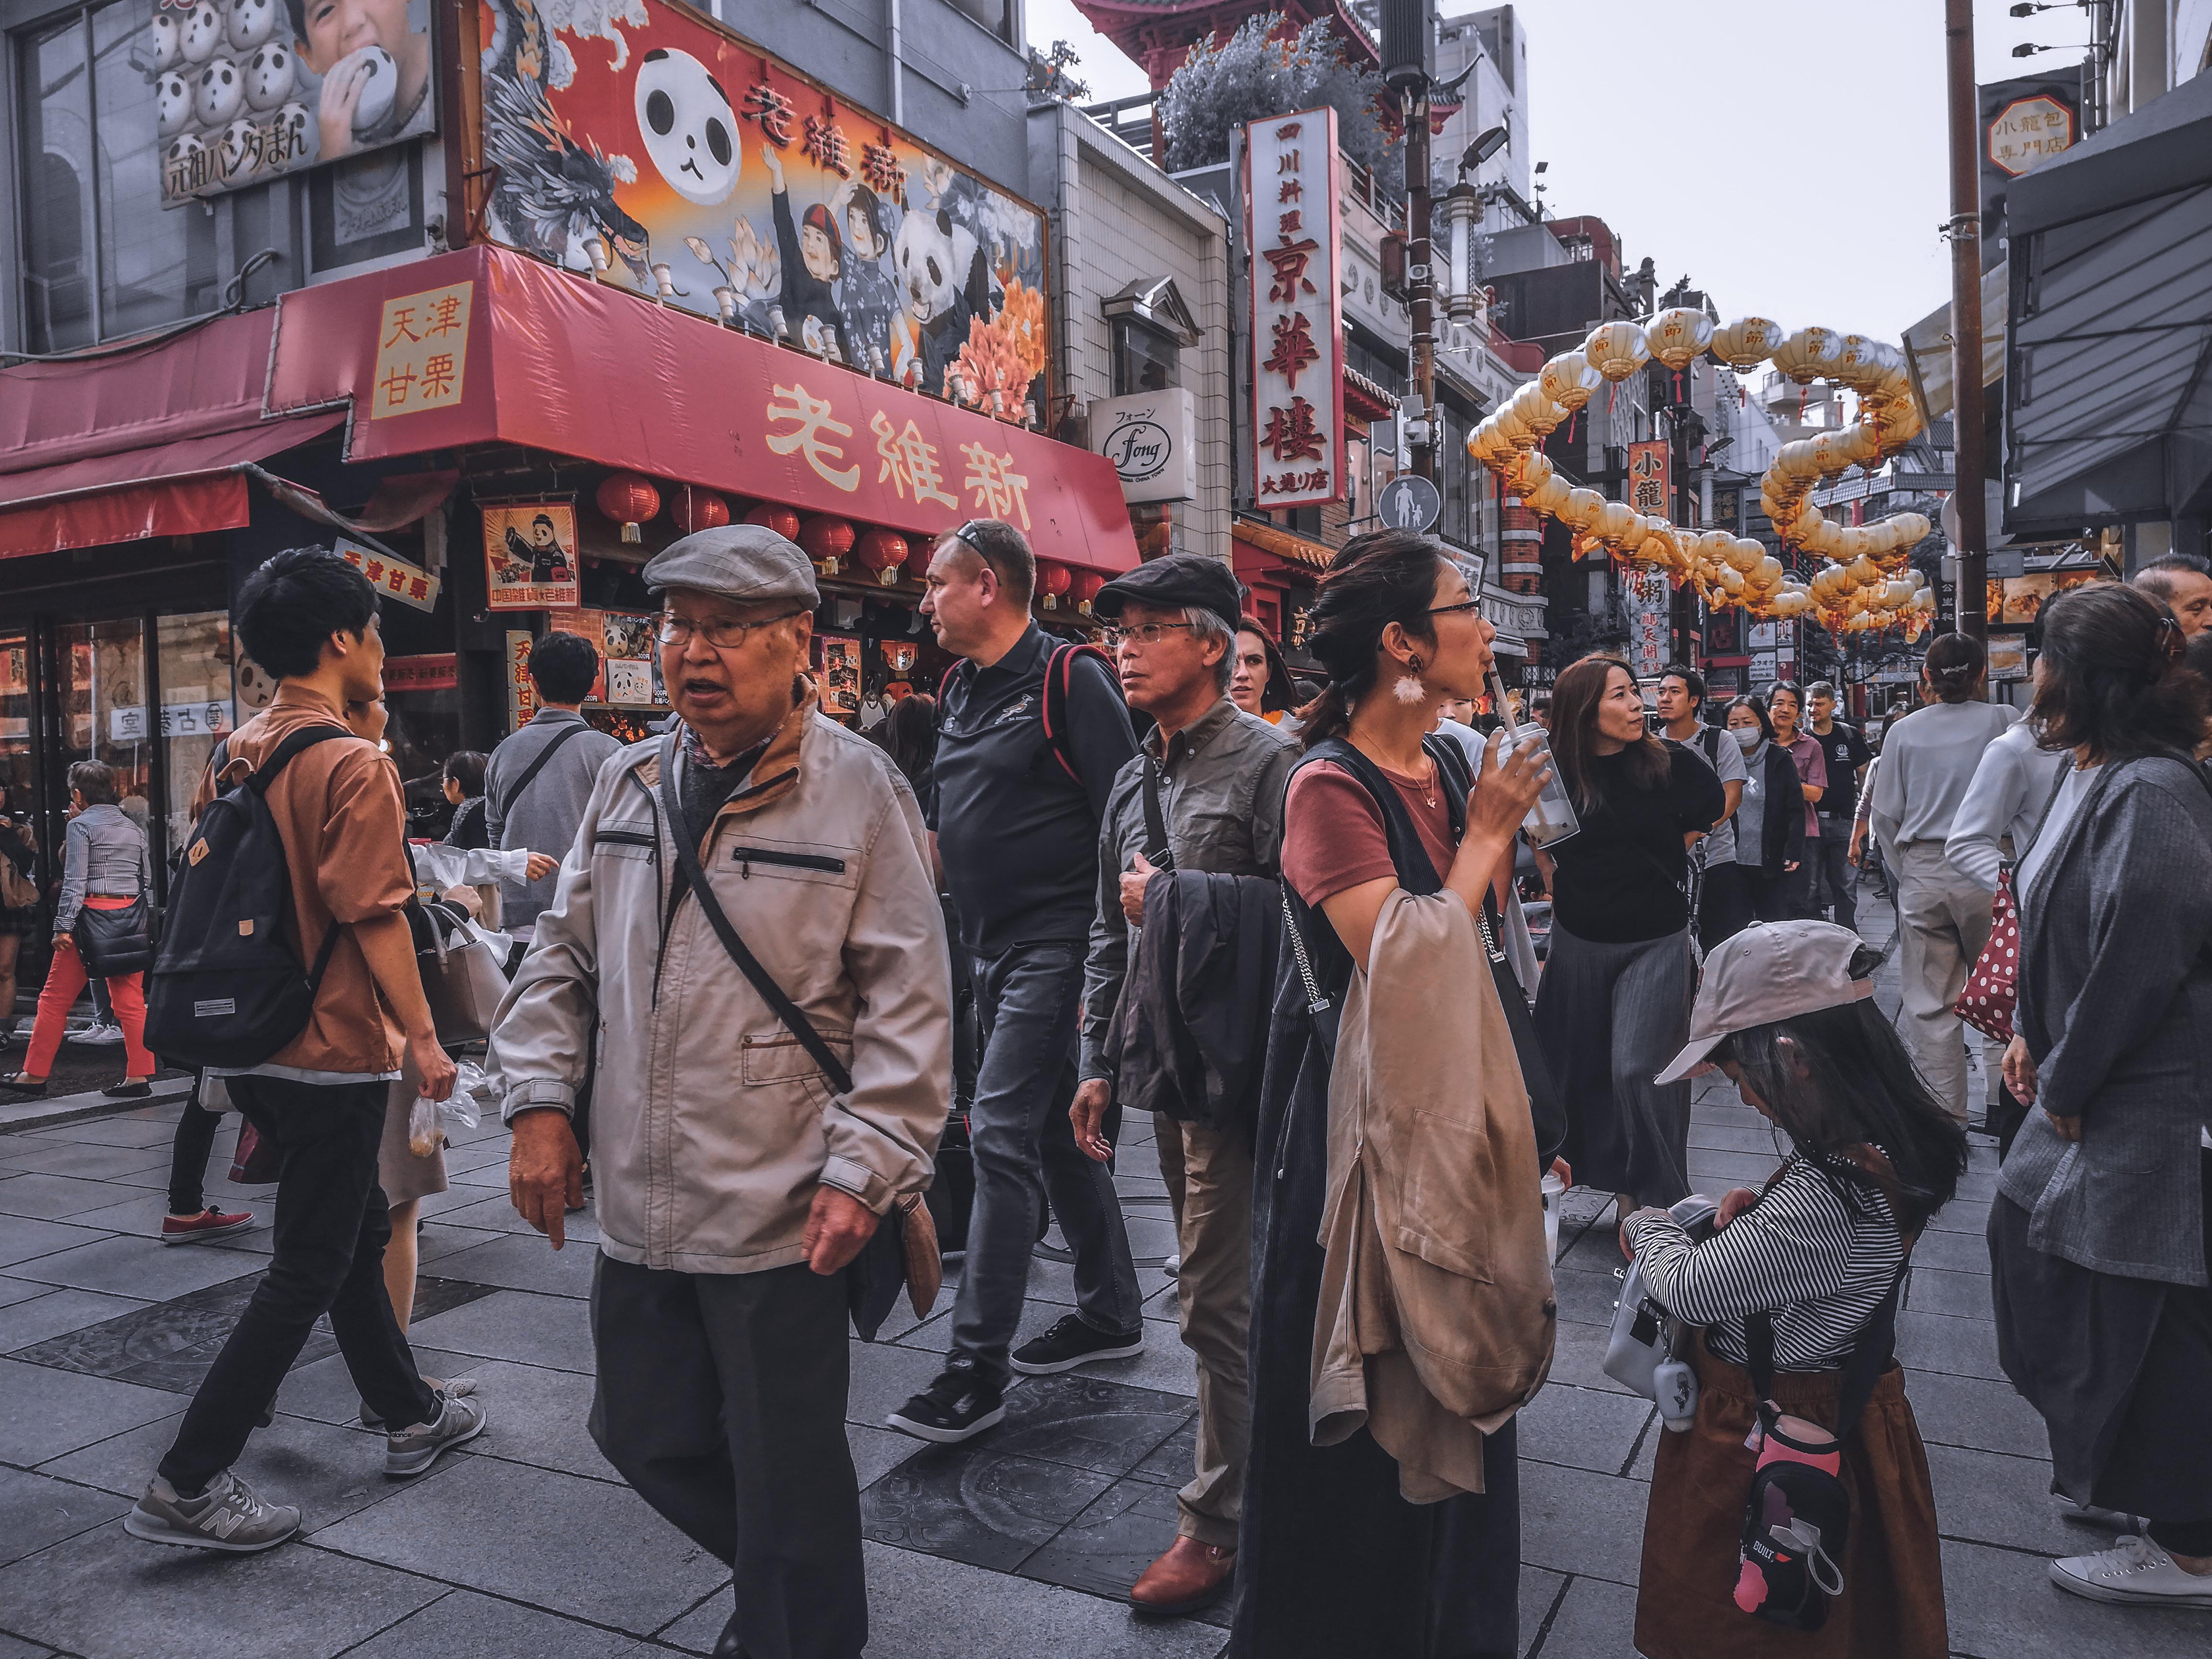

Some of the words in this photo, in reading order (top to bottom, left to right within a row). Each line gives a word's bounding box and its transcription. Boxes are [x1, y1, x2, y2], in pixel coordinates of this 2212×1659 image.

[168, 120, 308, 195] 元祖パンダまん
[741, 84, 911, 205] 老維新
[1275, 122, 1303, 233] 四川料理
[1116, 408, 1155, 424] フォーン
[766, 384, 1031, 531] 老維新
[1151, 468, 1165, 479] TOWN
[1261, 468, 1330, 495] 大通り店
[200, 1507, 245, 1539] N
[1753, 1540, 1774, 1559] BUILT
